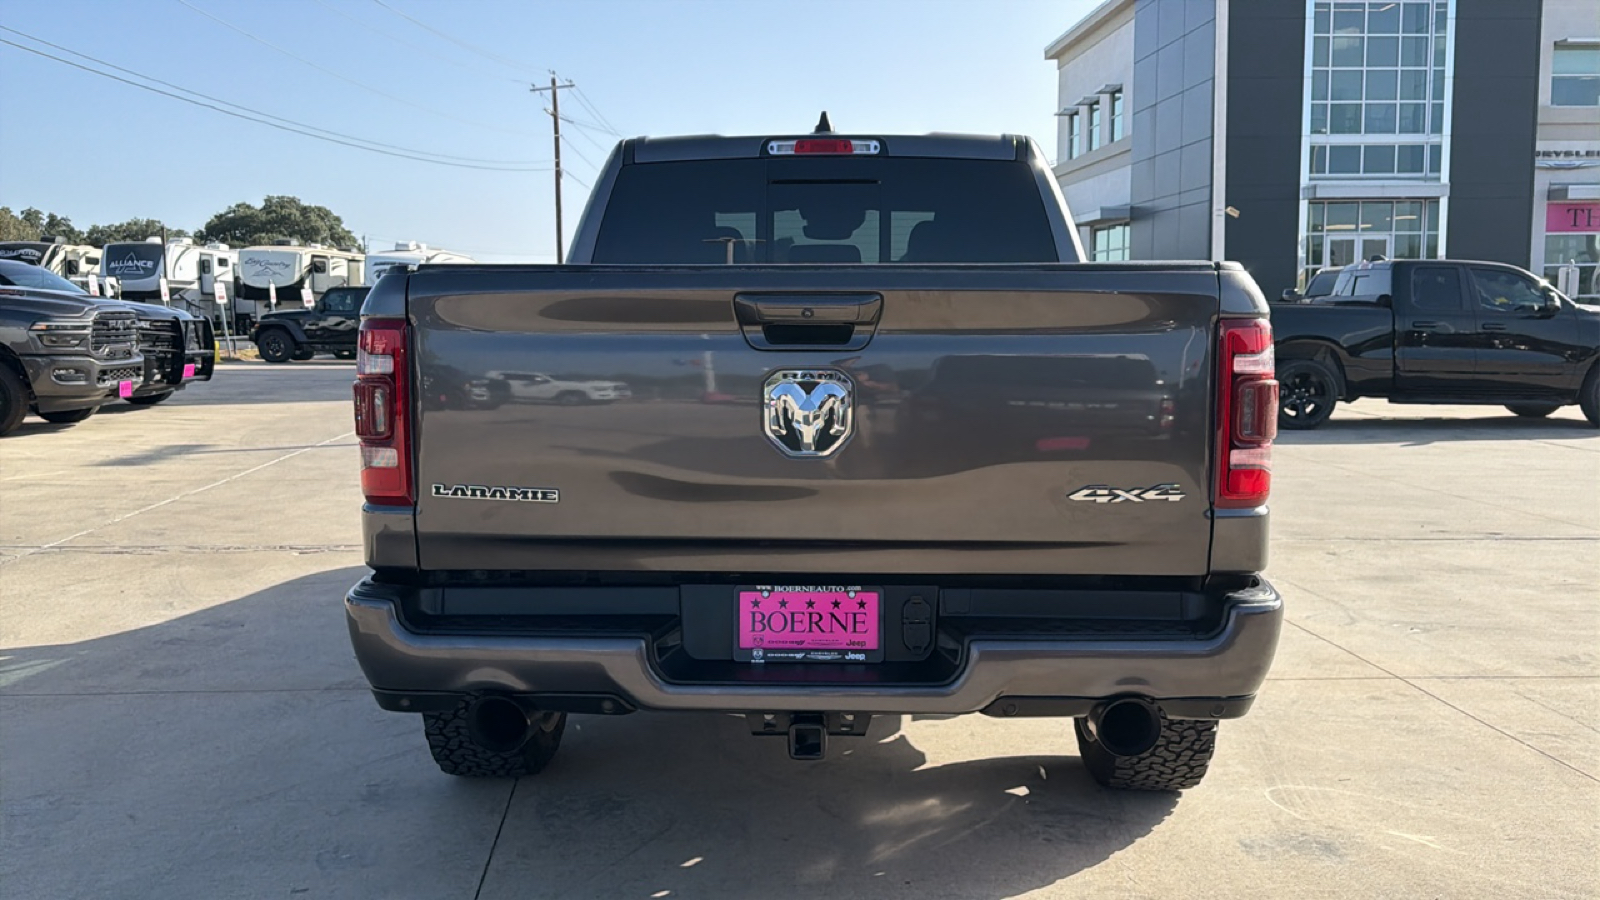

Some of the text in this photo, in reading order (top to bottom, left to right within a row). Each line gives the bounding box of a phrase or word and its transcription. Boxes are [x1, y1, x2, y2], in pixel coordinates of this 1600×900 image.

[109, 260, 154, 268] ALLIANCE
[782, 372, 835, 380] RAM
[432, 484, 559, 502] LARAMIE
[750, 611, 868, 633] BOERNE
[846, 639, 866, 647] Jeep
[845, 651, 866, 660] Jeep
